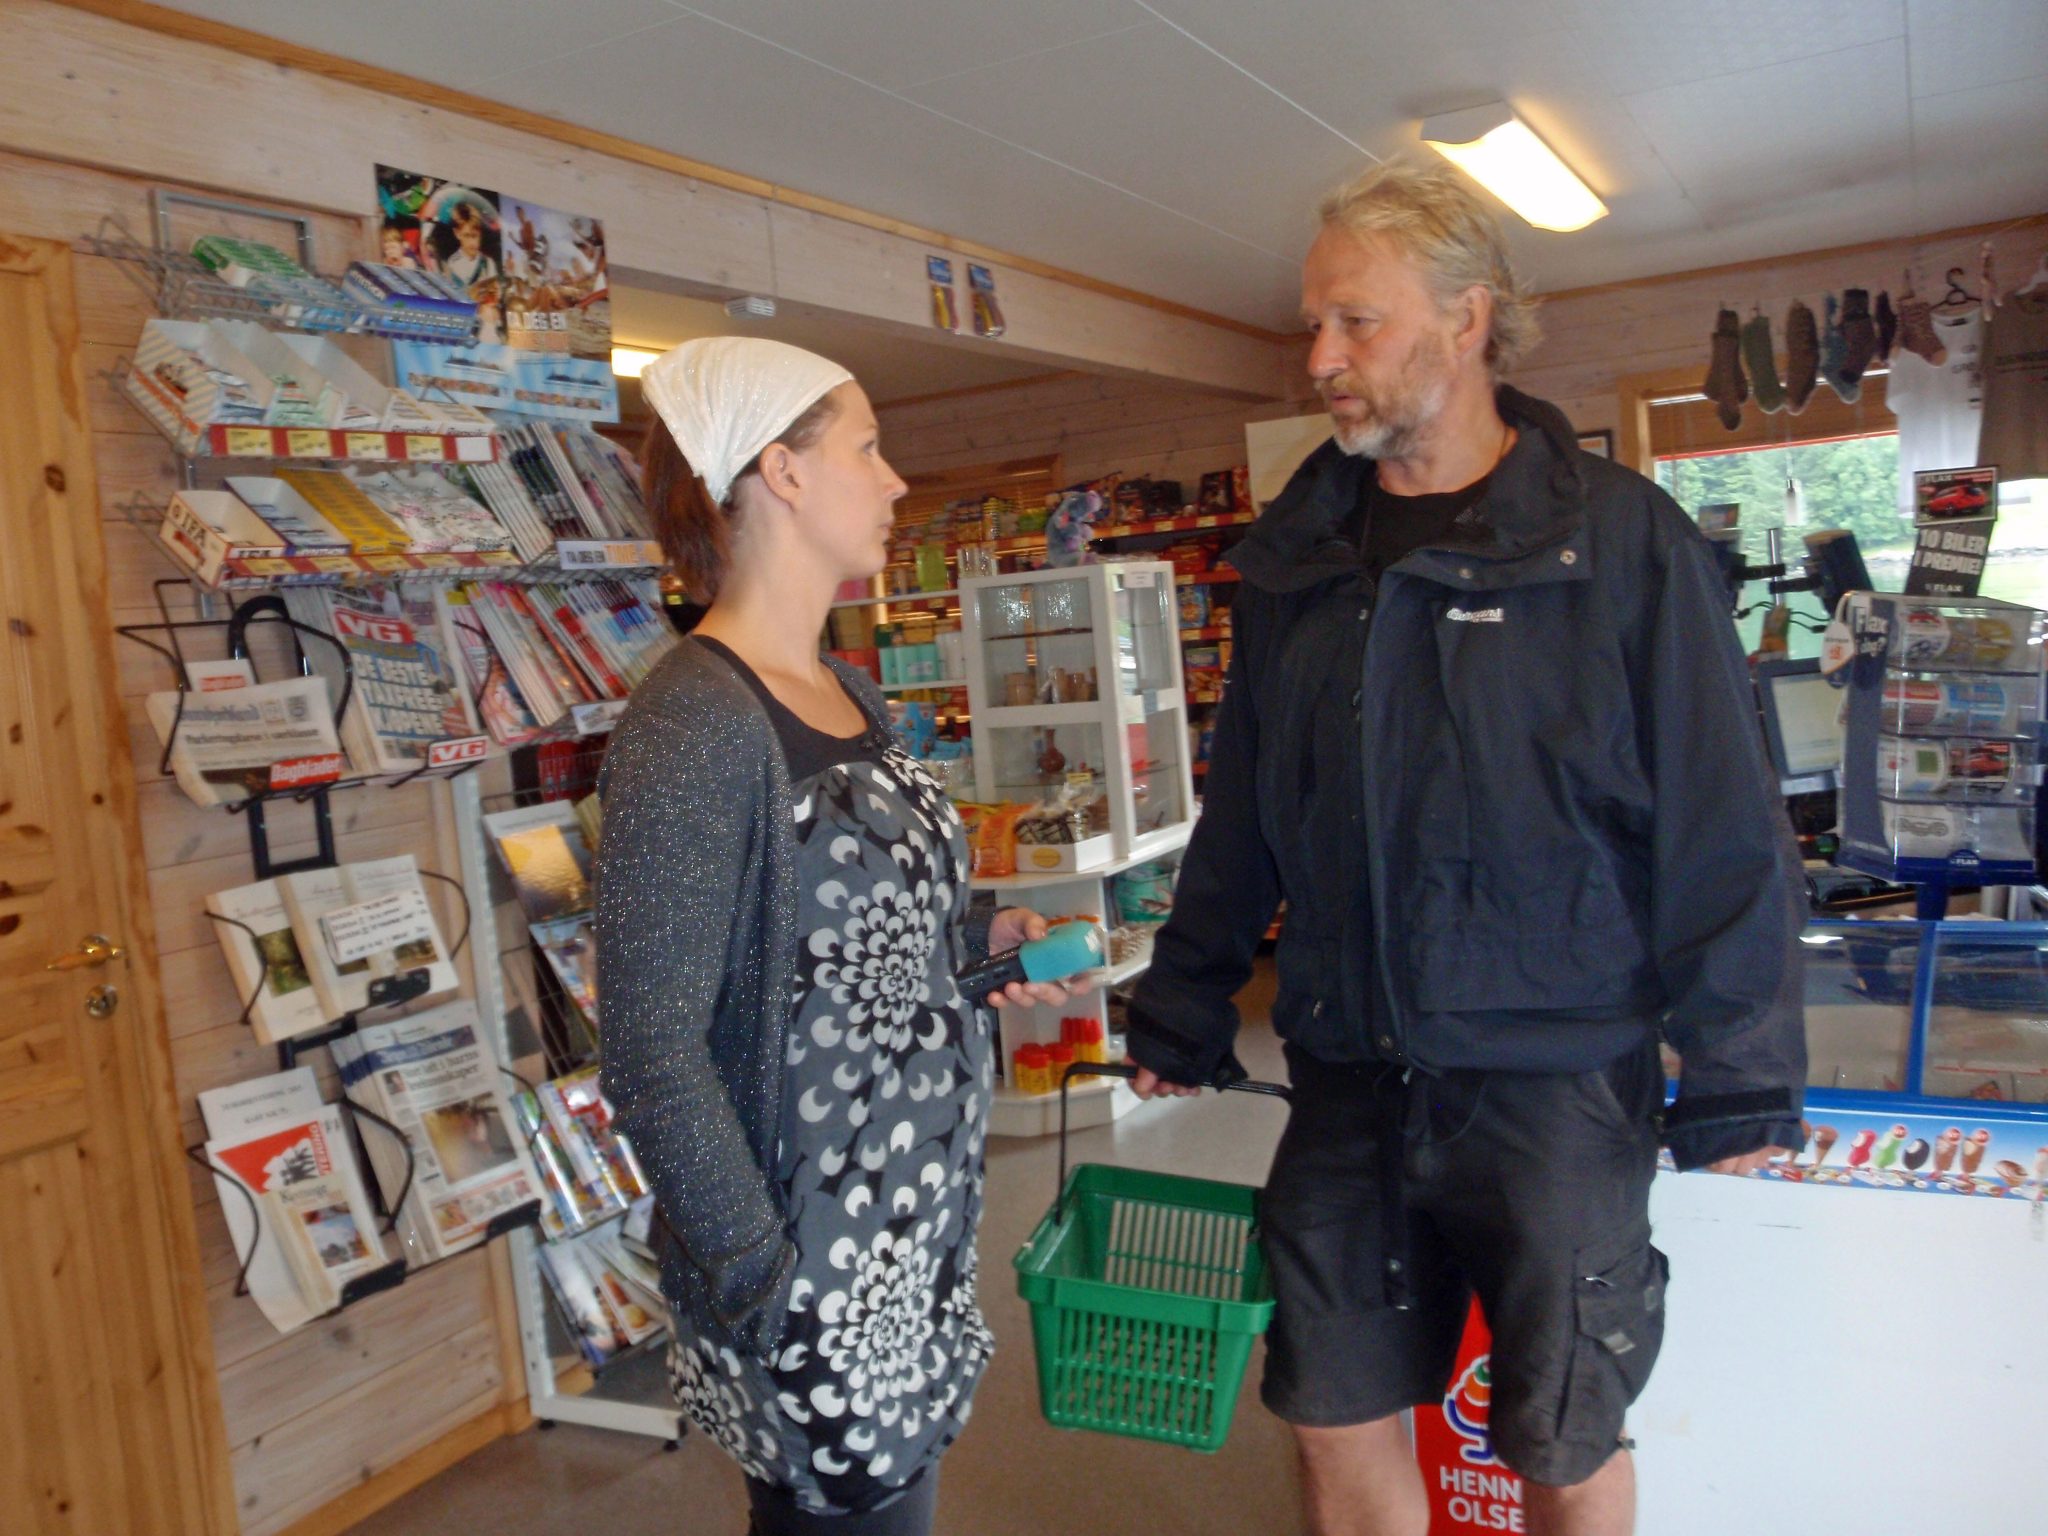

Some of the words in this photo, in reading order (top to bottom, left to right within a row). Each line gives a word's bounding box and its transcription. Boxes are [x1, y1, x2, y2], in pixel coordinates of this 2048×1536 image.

[1918, 529, 1940, 549] 10
[1941, 530, 1987, 556] BILER
[336, 612, 406, 644] VG
[433, 741, 488, 765] VG
[270, 756, 345, 784] Dagbladet
[1440, 1465, 1522, 1504] HENN
[1448, 1497, 1525, 1534] OLSE
